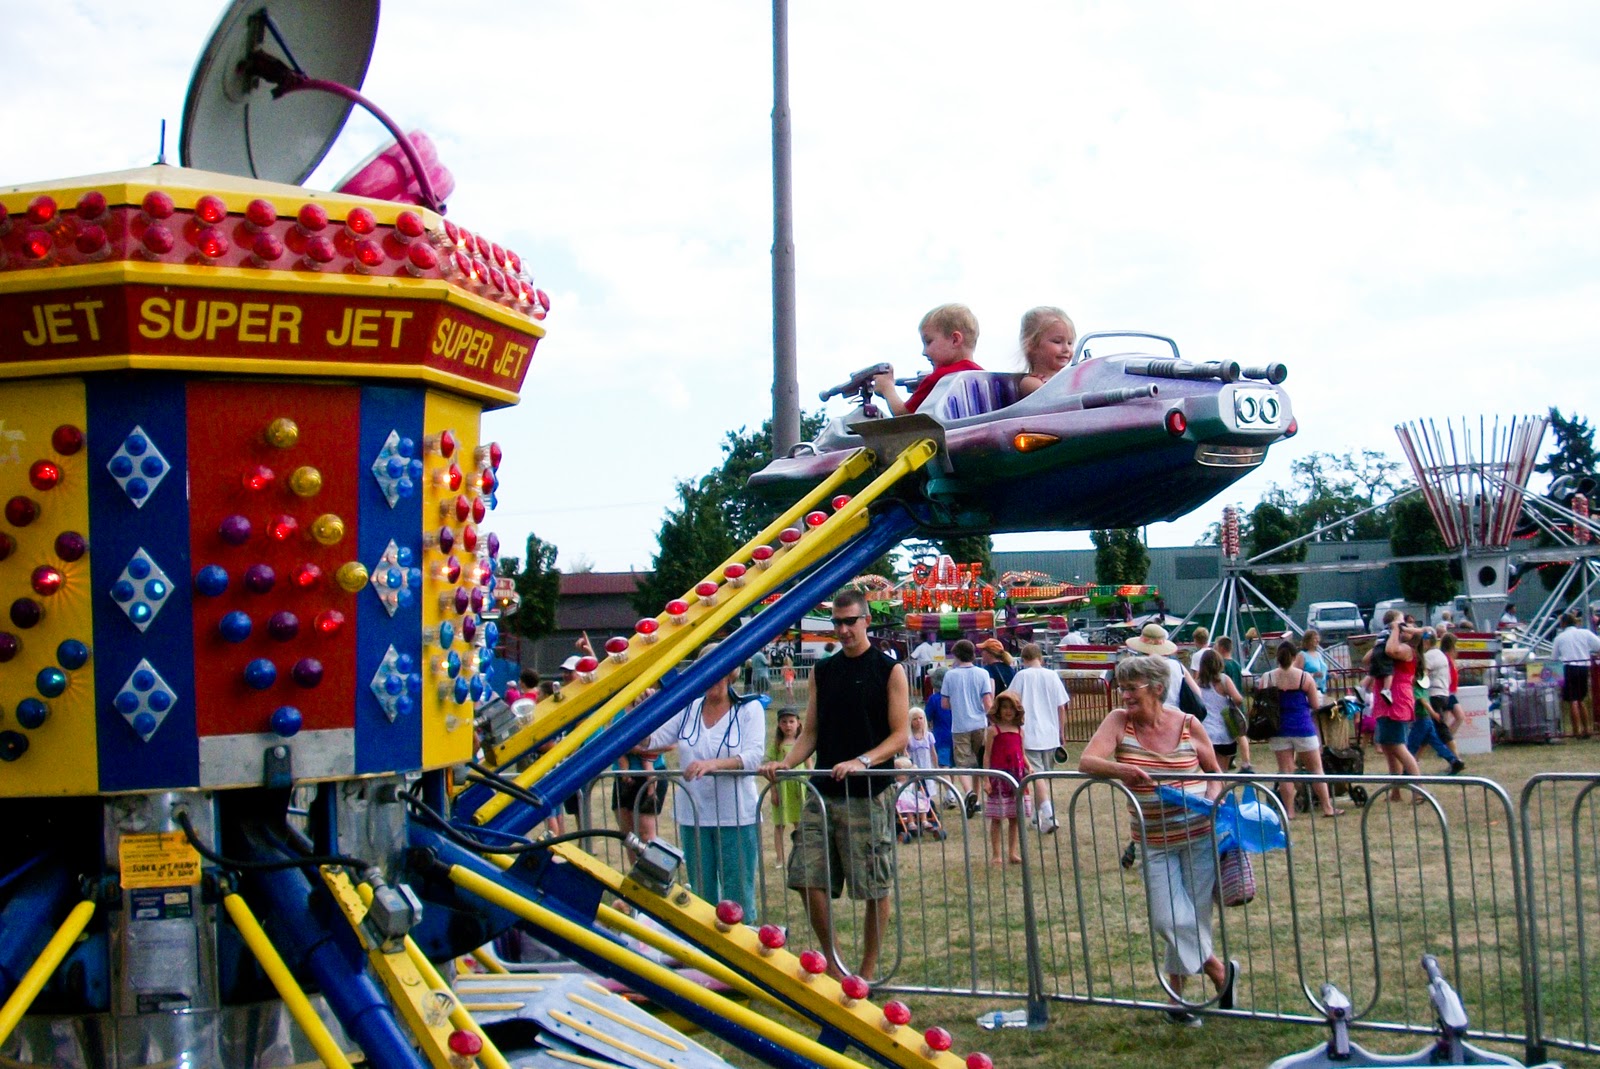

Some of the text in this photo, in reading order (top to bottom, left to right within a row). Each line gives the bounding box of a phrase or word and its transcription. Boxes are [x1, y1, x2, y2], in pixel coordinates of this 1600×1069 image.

[22, 300, 104, 347] JET
[138, 297, 413, 348] SUPER JET
[432, 317, 529, 379] SUPER JET
[912, 561, 983, 586] CLIFF
[902, 586, 995, 611] HANGER
